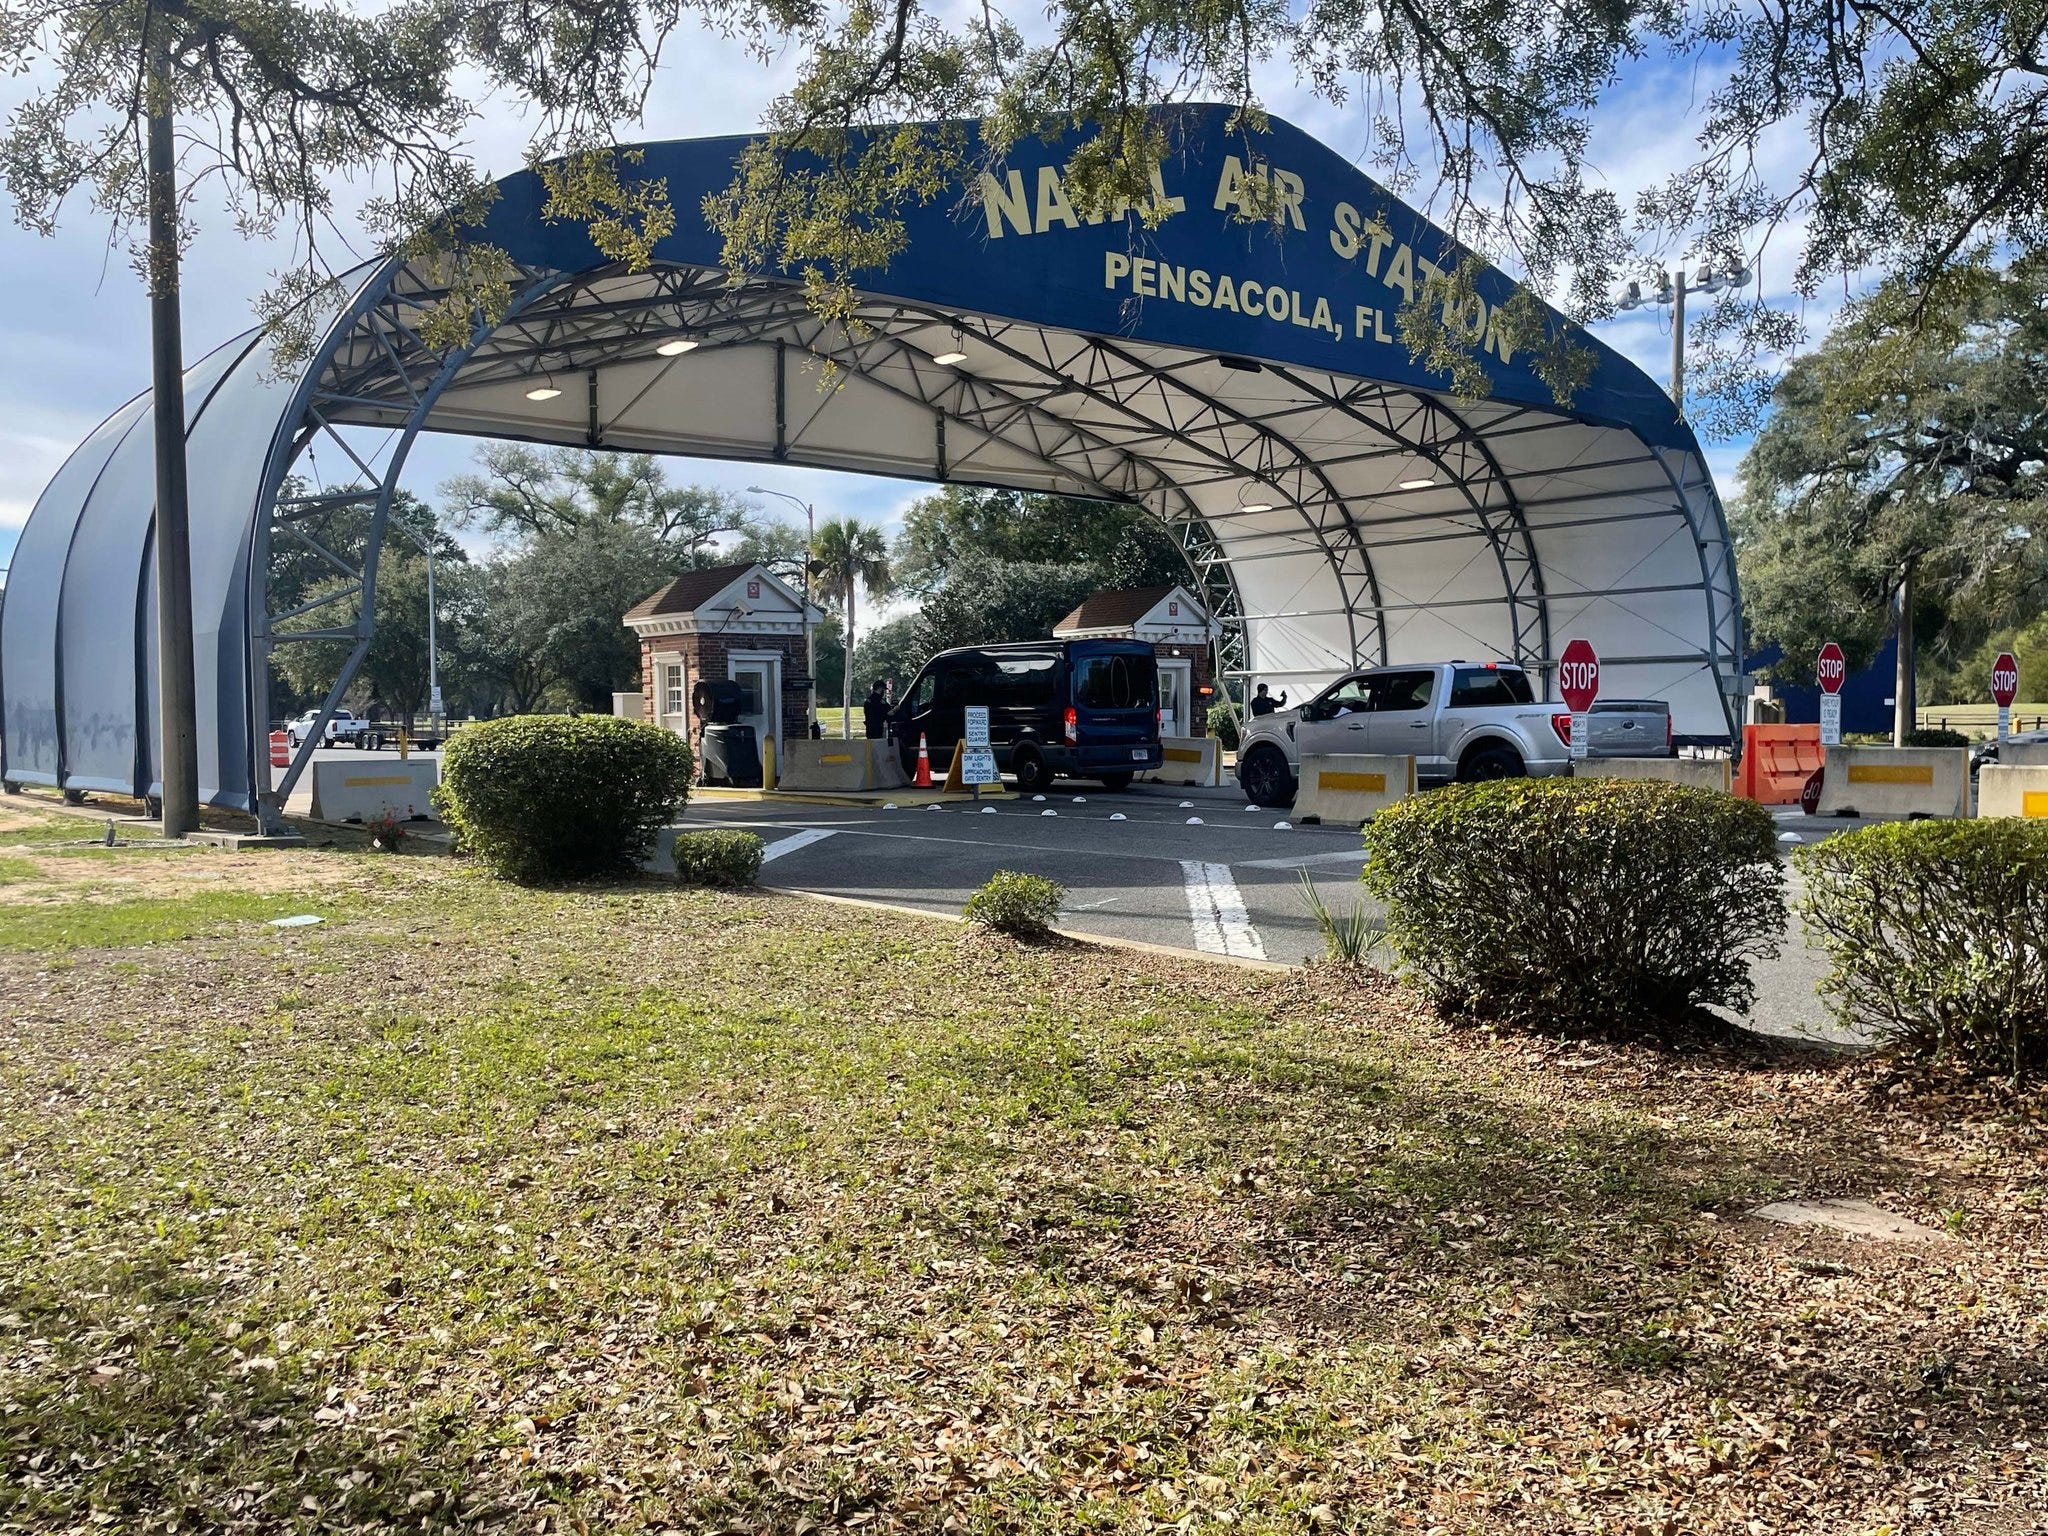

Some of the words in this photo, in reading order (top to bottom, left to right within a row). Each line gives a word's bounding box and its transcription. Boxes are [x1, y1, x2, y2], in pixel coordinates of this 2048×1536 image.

[1213, 155, 1307, 231] AIR
[1105, 251, 1343, 342] PENSACOLA,
[1356, 305, 1393, 344] FL
[1561, 662, 1597, 690] STOP
[1819, 659, 1843, 679] STOP
[1993, 671, 2016, 691] STOP
[1803, 782, 1821, 800] OP
